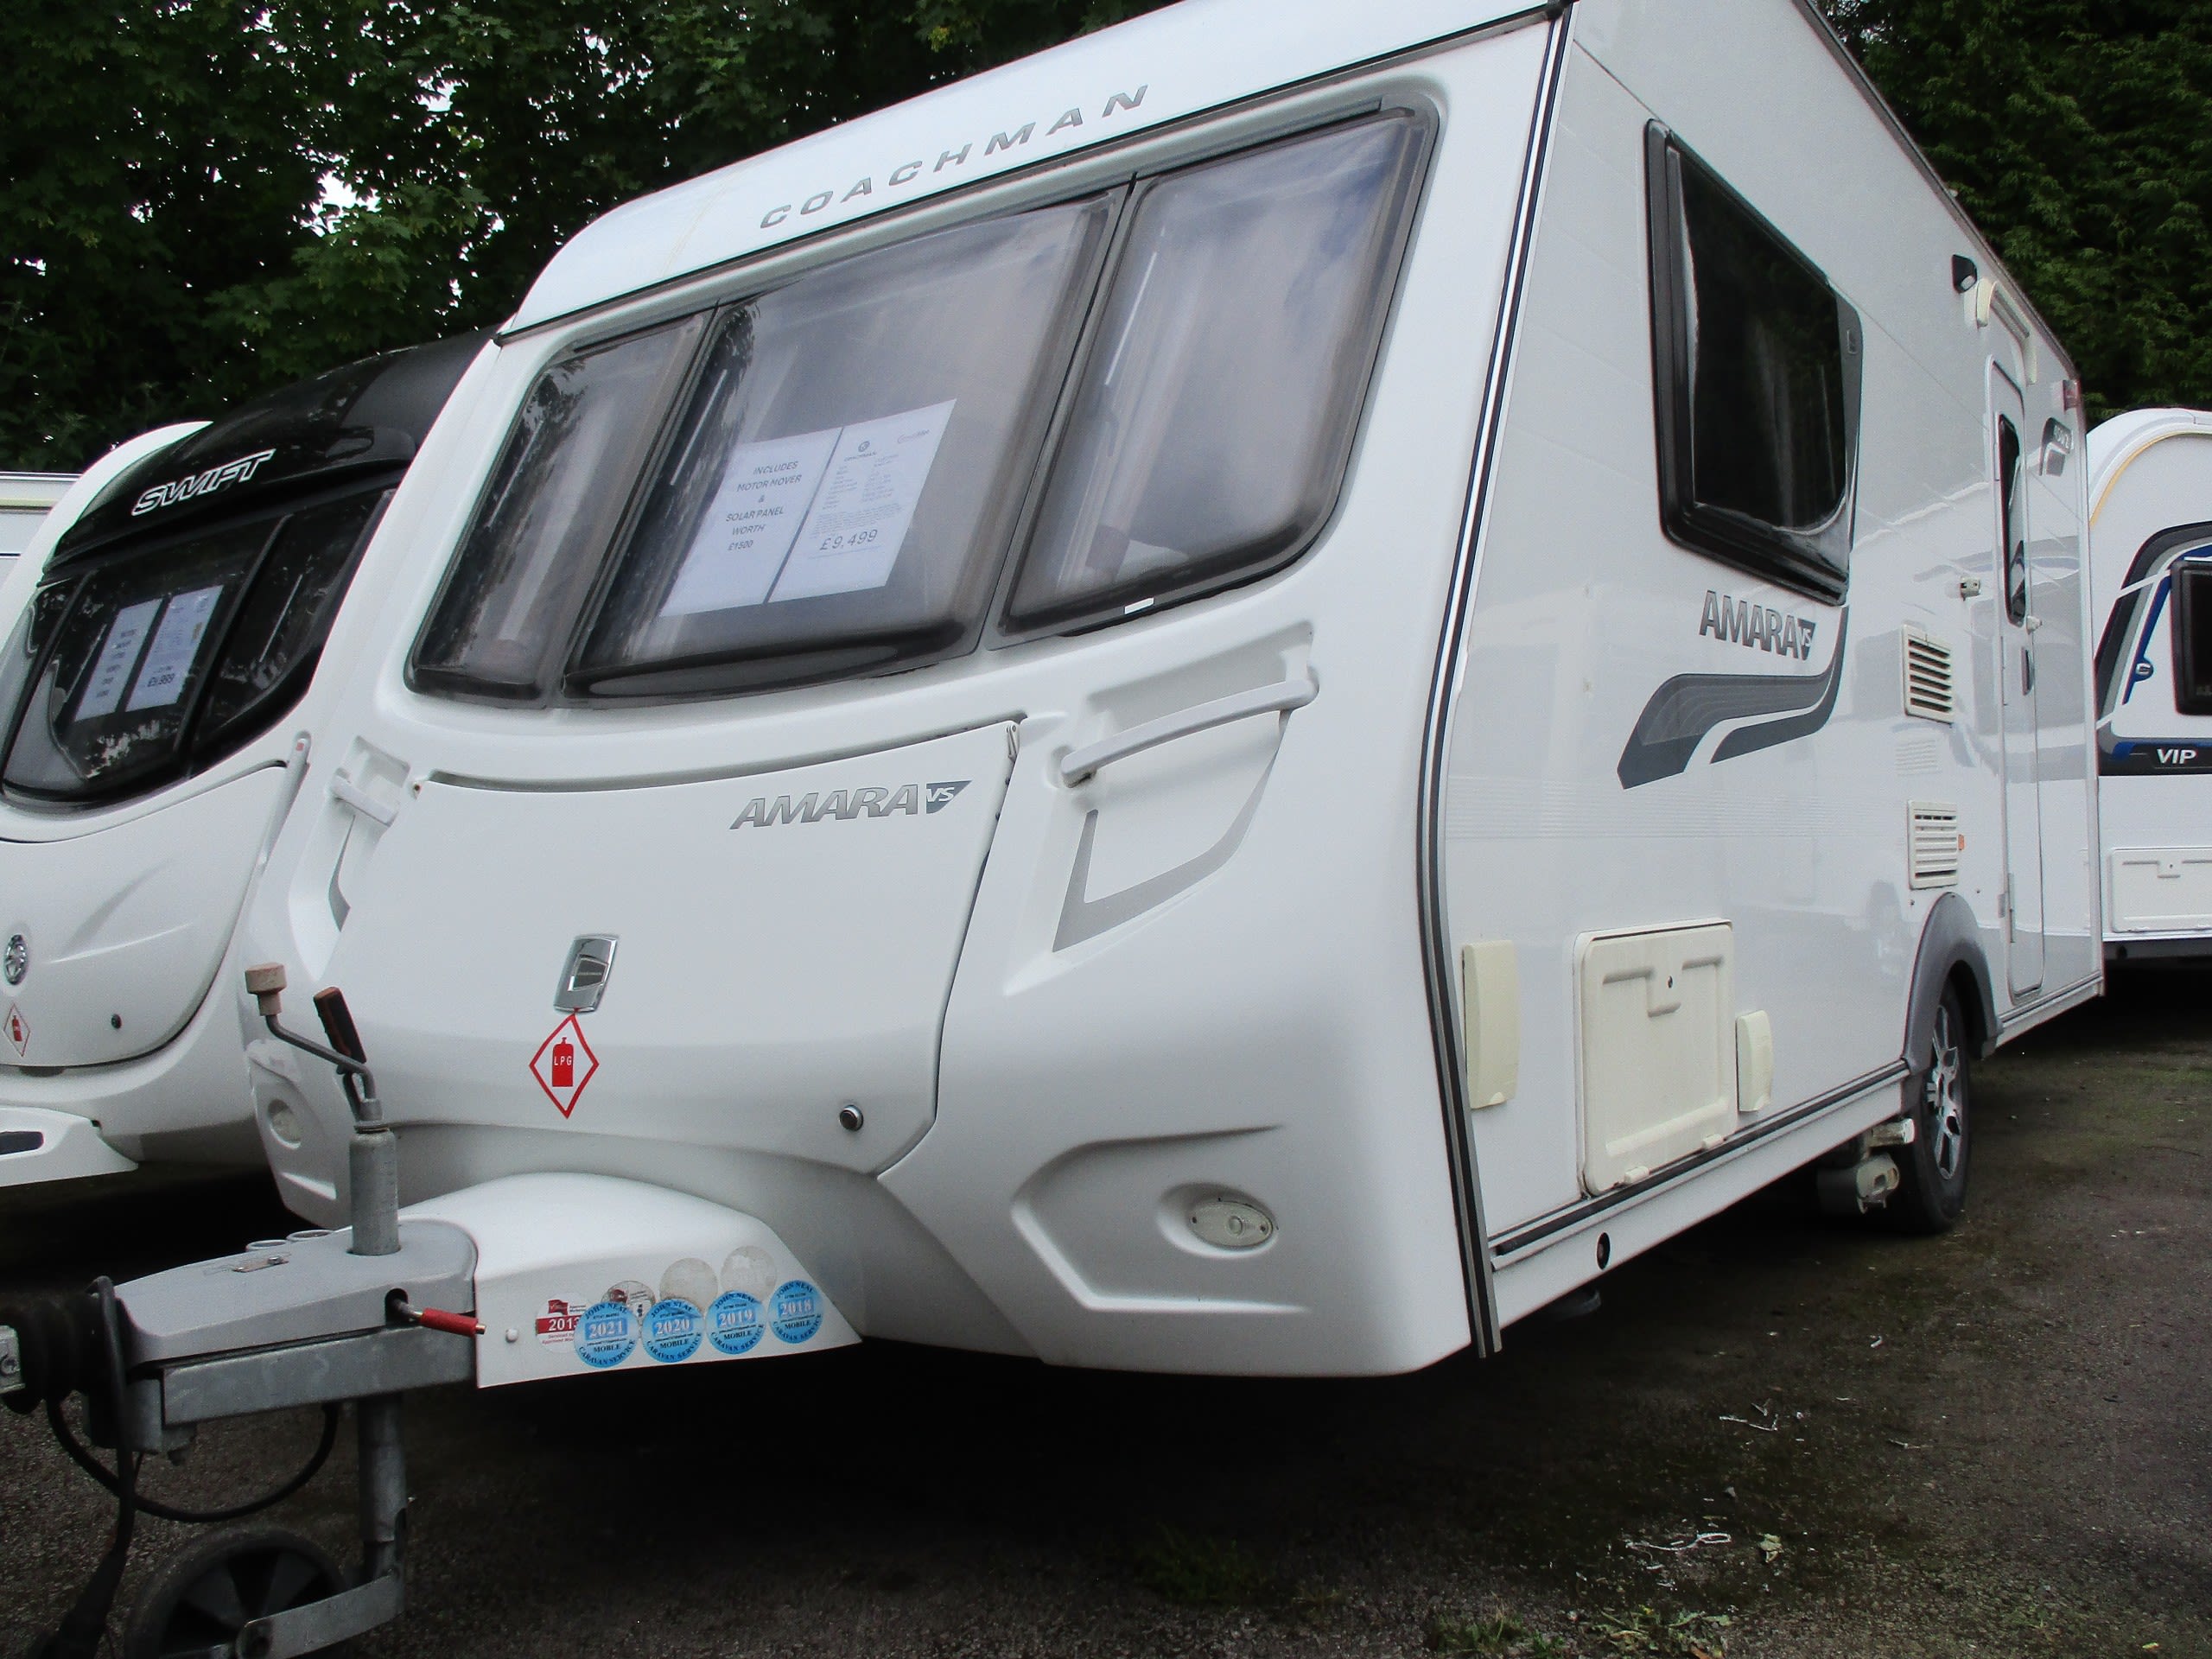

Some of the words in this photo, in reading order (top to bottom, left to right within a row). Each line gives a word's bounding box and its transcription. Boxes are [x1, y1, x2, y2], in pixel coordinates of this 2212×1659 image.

[760, 85, 1148, 229] COACHMAN
[753, 461, 798, 474] INCLUDES
[131, 448, 276, 516] SWIFT
[737, 480, 768, 492] MOTOR
[770, 474, 802, 486] MOVER
[726, 512, 756, 522] SOLAR
[756, 506, 785, 518] PANEL
[732, 524, 766, 535] WORTH
[728, 540, 754, 551] £1500
[1699, 589, 1799, 659] AMARA
[2157, 748, 2196, 765] VIP
[729, 784, 918, 830] AMARA
[926, 786, 955, 803] VS
[554, 1056, 572, 1066] LPG
[777, 1283, 794, 1297] JOHN
[715, 1294, 734, 1308] JOHN
[780, 1298, 811, 1315] 2018
[585, 1304, 605, 1319] JOHN
[652, 1302, 671, 1318] JOHN
[719, 1309, 753, 1328] 2019
[785, 1321, 811, 1330] MOBILE
[589, 1320, 622, 1338] 2021
[656, 1319, 690, 1334] 2020
[724, 1331, 752, 1339] MOBILE
[660, 1338, 689, 1348] MOBILE
